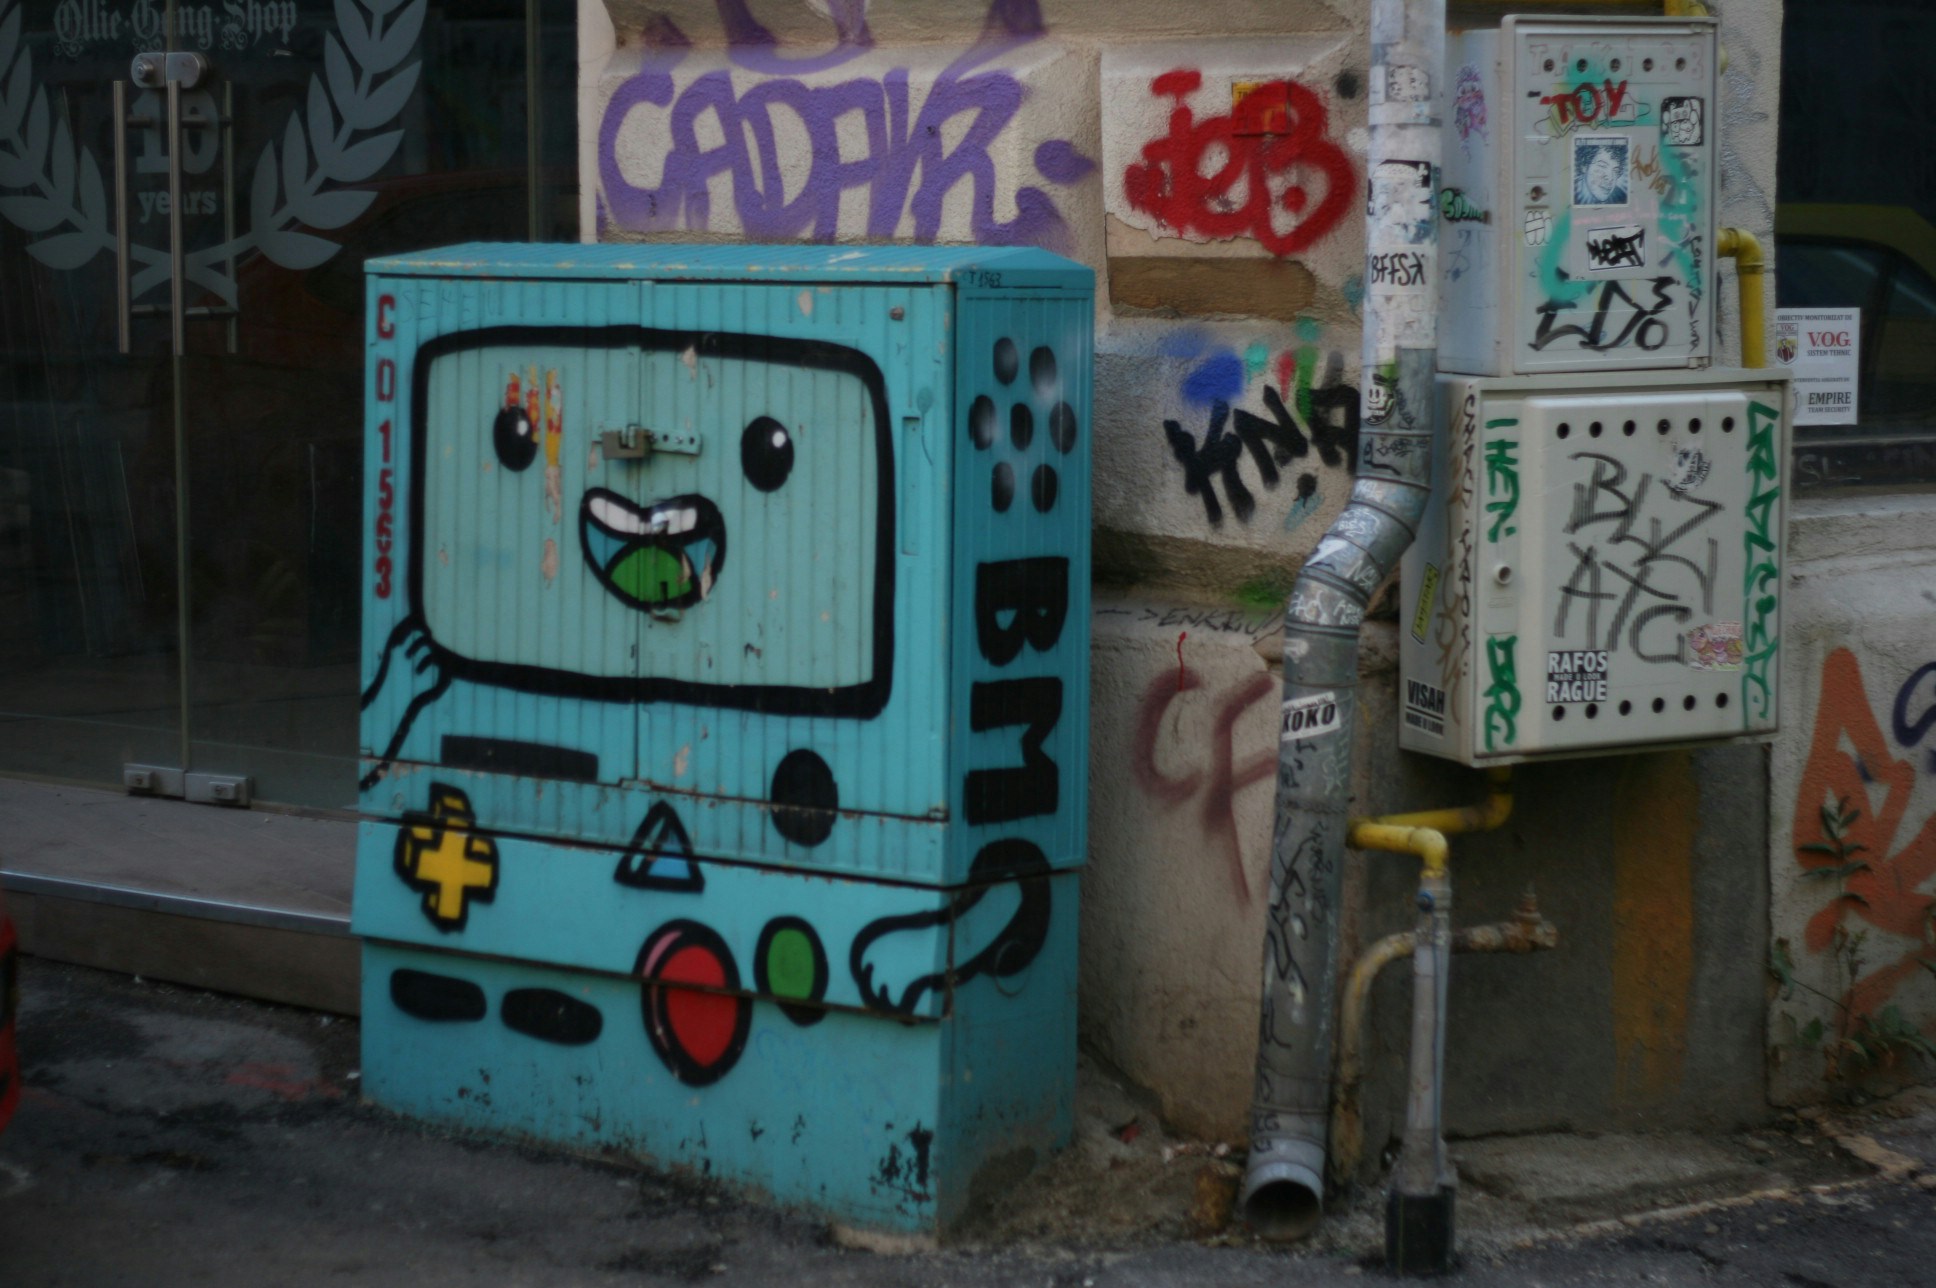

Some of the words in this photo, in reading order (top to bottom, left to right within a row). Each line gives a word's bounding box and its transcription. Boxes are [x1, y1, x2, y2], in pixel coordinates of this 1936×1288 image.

[1540, 78, 1628, 125] TOY
[132, 87, 219, 175] 10
[1807, 349, 1829, 357] SISTEM
[1808, 391, 1852, 405] EMPIRE
[1549, 651, 1608, 673] RAFOS
[1547, 681, 1607, 703] RAGUE
